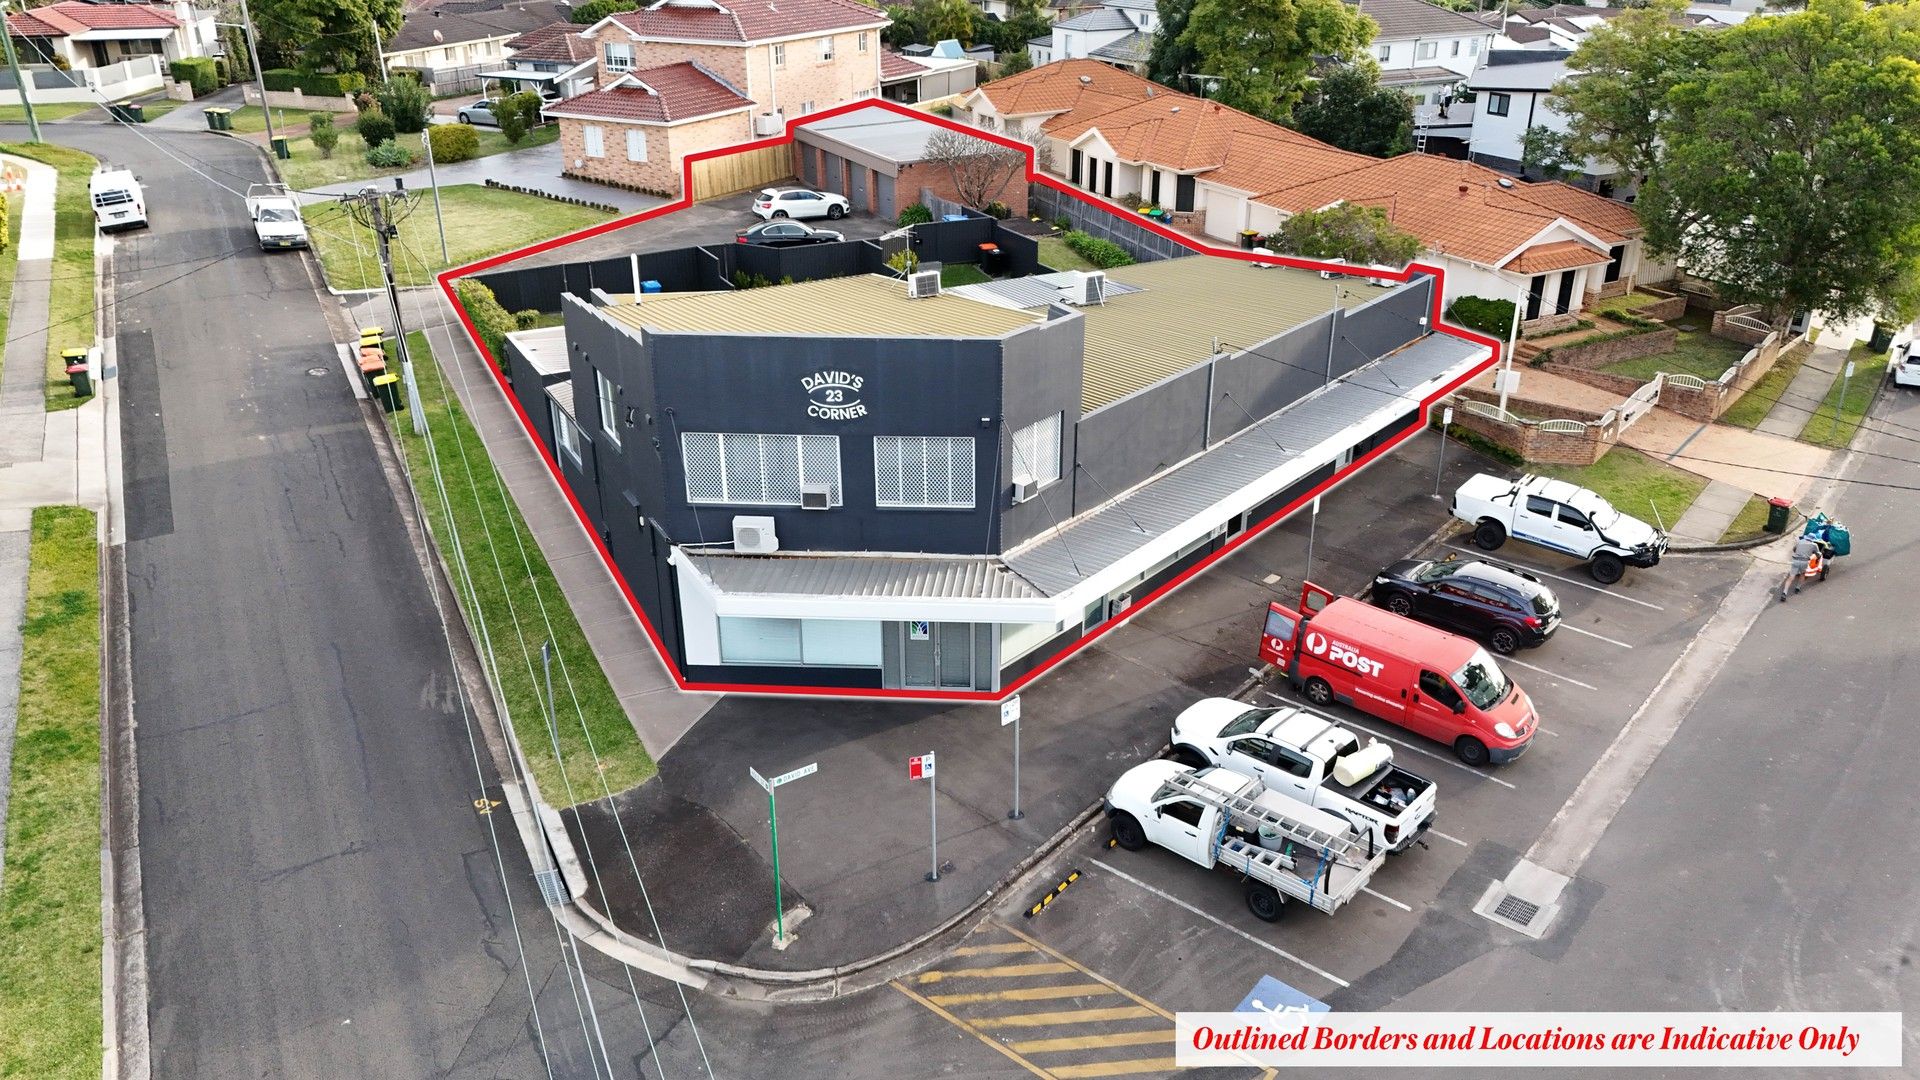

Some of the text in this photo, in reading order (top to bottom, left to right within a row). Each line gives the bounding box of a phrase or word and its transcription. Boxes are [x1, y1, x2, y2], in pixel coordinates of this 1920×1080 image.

[825, 389, 843, 402] 23
[807, 404, 868, 420] CORNER
[1331, 640, 1360, 655] AUSTRALIA
[1328, 645, 1385, 678] POST
[783, 765, 816, 783] DAVID AVE
[1345, 807, 1379, 826] RAPTOR
